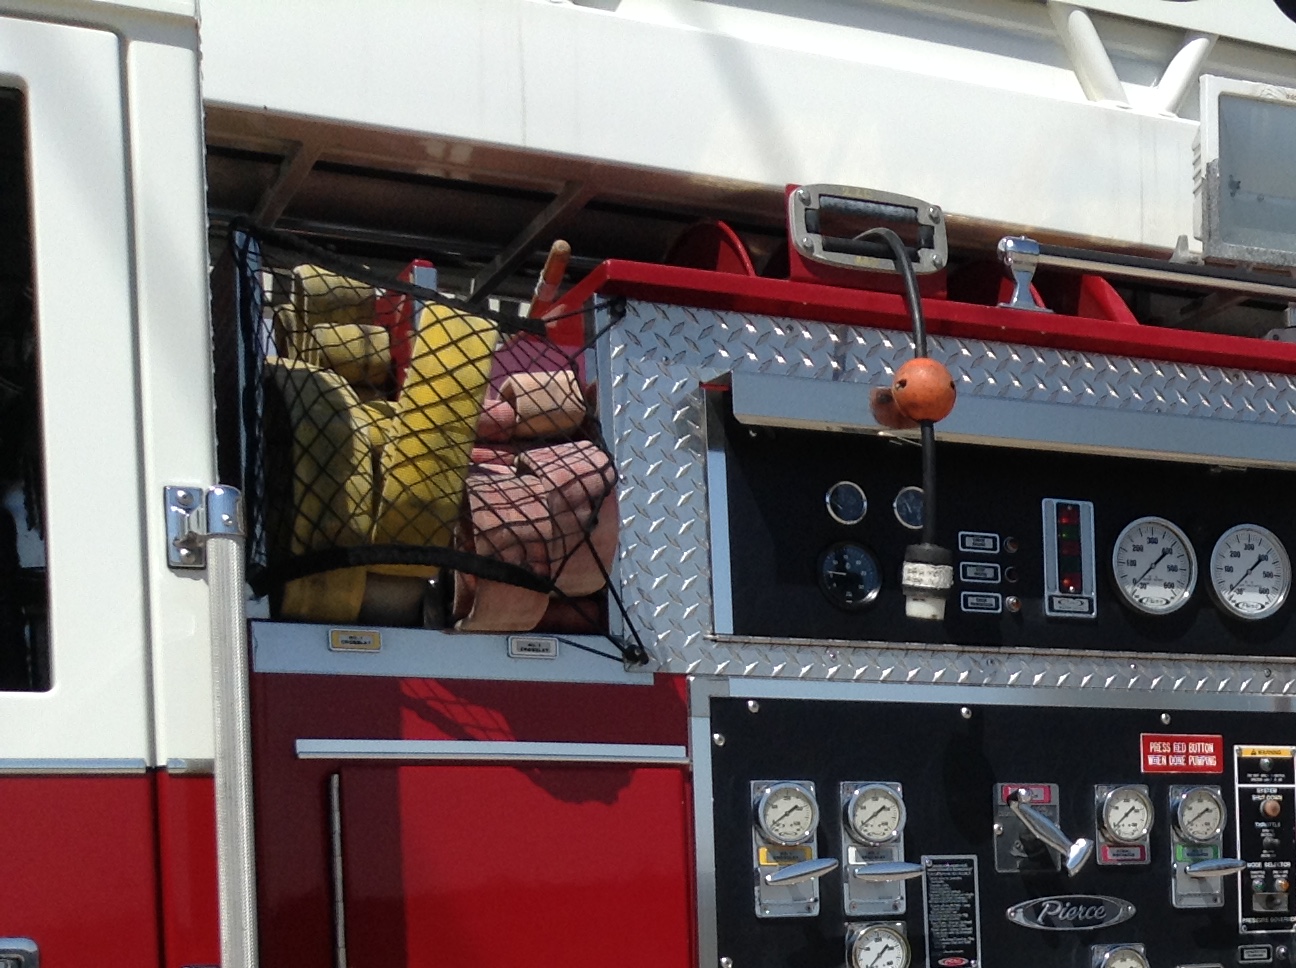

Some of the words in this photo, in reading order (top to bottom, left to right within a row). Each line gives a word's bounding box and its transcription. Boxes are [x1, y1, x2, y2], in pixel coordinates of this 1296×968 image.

[1150, 742, 1171, 753] PRESS
[1188, 743, 1214, 753] BUTTON
[1037, 900, 1107, 925] Pierce
